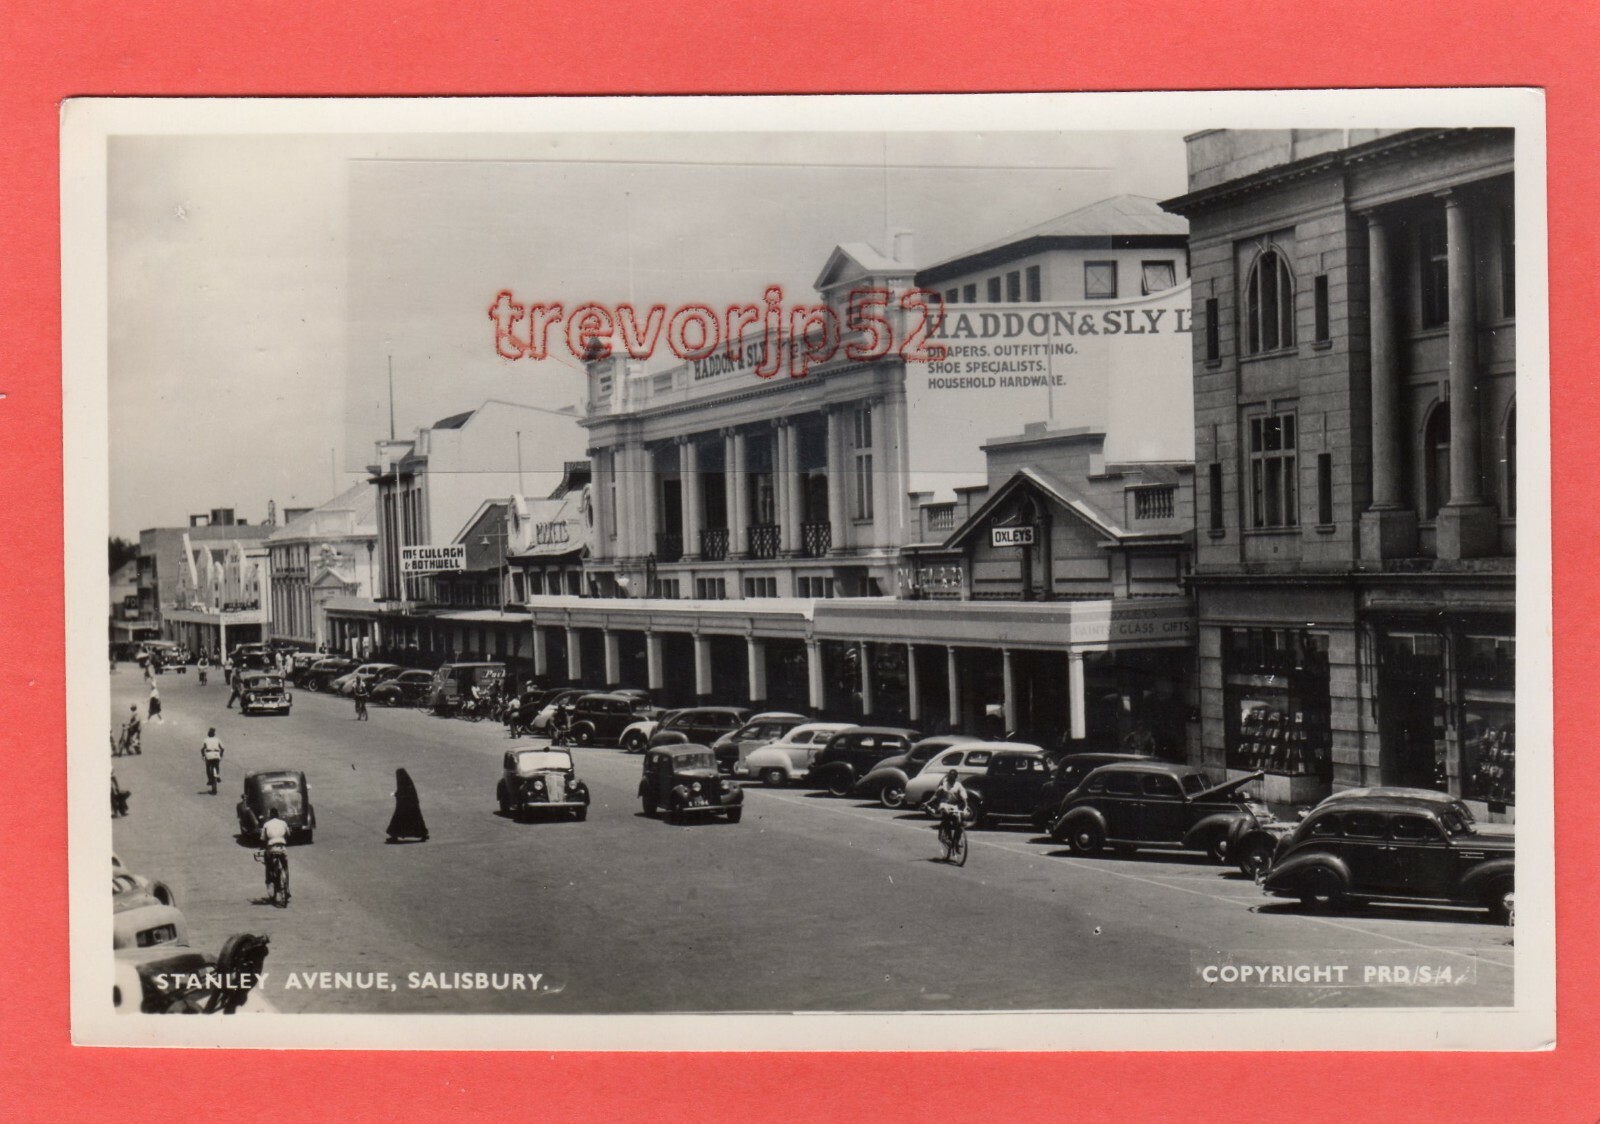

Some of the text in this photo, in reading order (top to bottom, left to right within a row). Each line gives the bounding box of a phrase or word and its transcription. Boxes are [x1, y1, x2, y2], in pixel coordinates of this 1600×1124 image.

[928, 362, 961, 374] SHOE
[928, 377, 996, 389] HOUSEHOLD
[412, 558, 460, 570] BOTHWELL
[1119, 623, 1155, 635] GLASS
[1162, 621, 1190, 633] GIFTS
